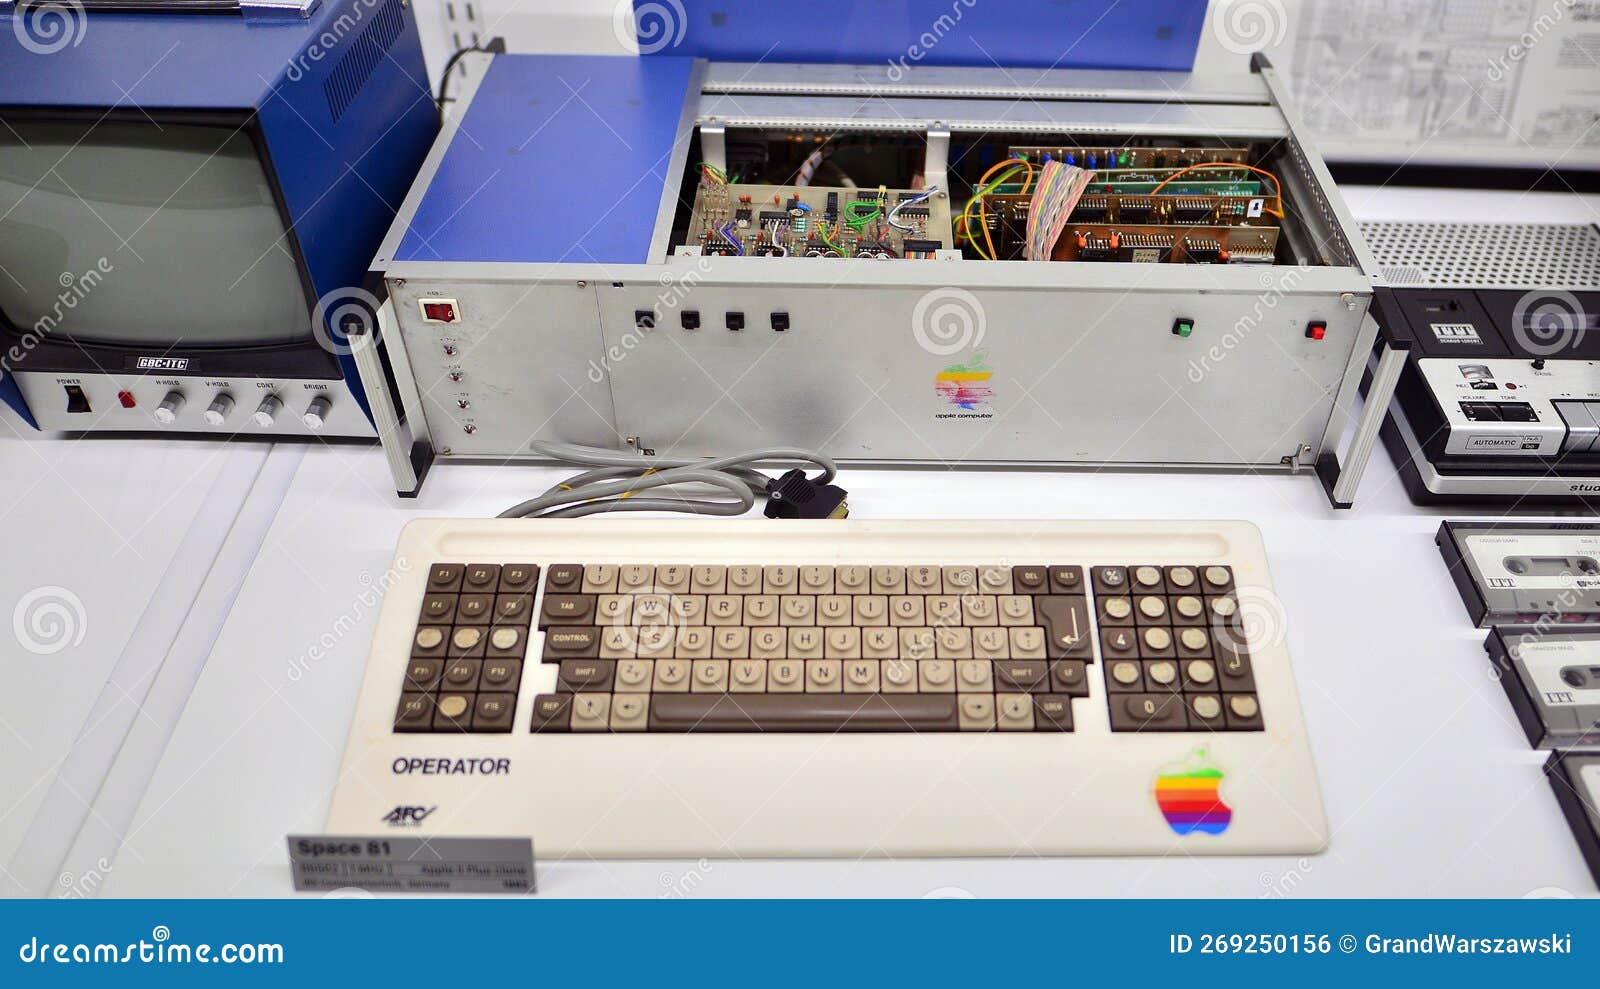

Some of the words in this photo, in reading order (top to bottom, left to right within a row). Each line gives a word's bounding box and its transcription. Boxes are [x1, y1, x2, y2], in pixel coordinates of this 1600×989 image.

[608, 601, 618, 611] Q
[644, 601, 658, 610] W
[682, 601, 692, 611] E
[719, 601, 728, 611] R
[758, 601, 764, 611] T
[829, 601, 838, 612] U
[939, 601, 948, 611] P
[652, 633, 661, 644] S
[689, 633, 698, 644] D
[726, 633, 735, 644] F
[763, 633, 773, 644] G
[801, 633, 811, 644] H
[840, 634, 846, 644] J
[875, 633, 885, 644] K
[575, 668, 596, 676] SHIFT
[667, 666, 676, 677] X
[705, 666, 714, 677] C
[744, 667, 752, 677] V
[781, 666, 790, 678] B
[819, 667, 829, 677] N
[856, 667, 867, 677] M
[1011, 668, 1032, 676] SHIFT
[392, 758, 511, 775] OPERATOR
[297, 839, 362, 857] Space
[366, 839, 391, 856] 81
